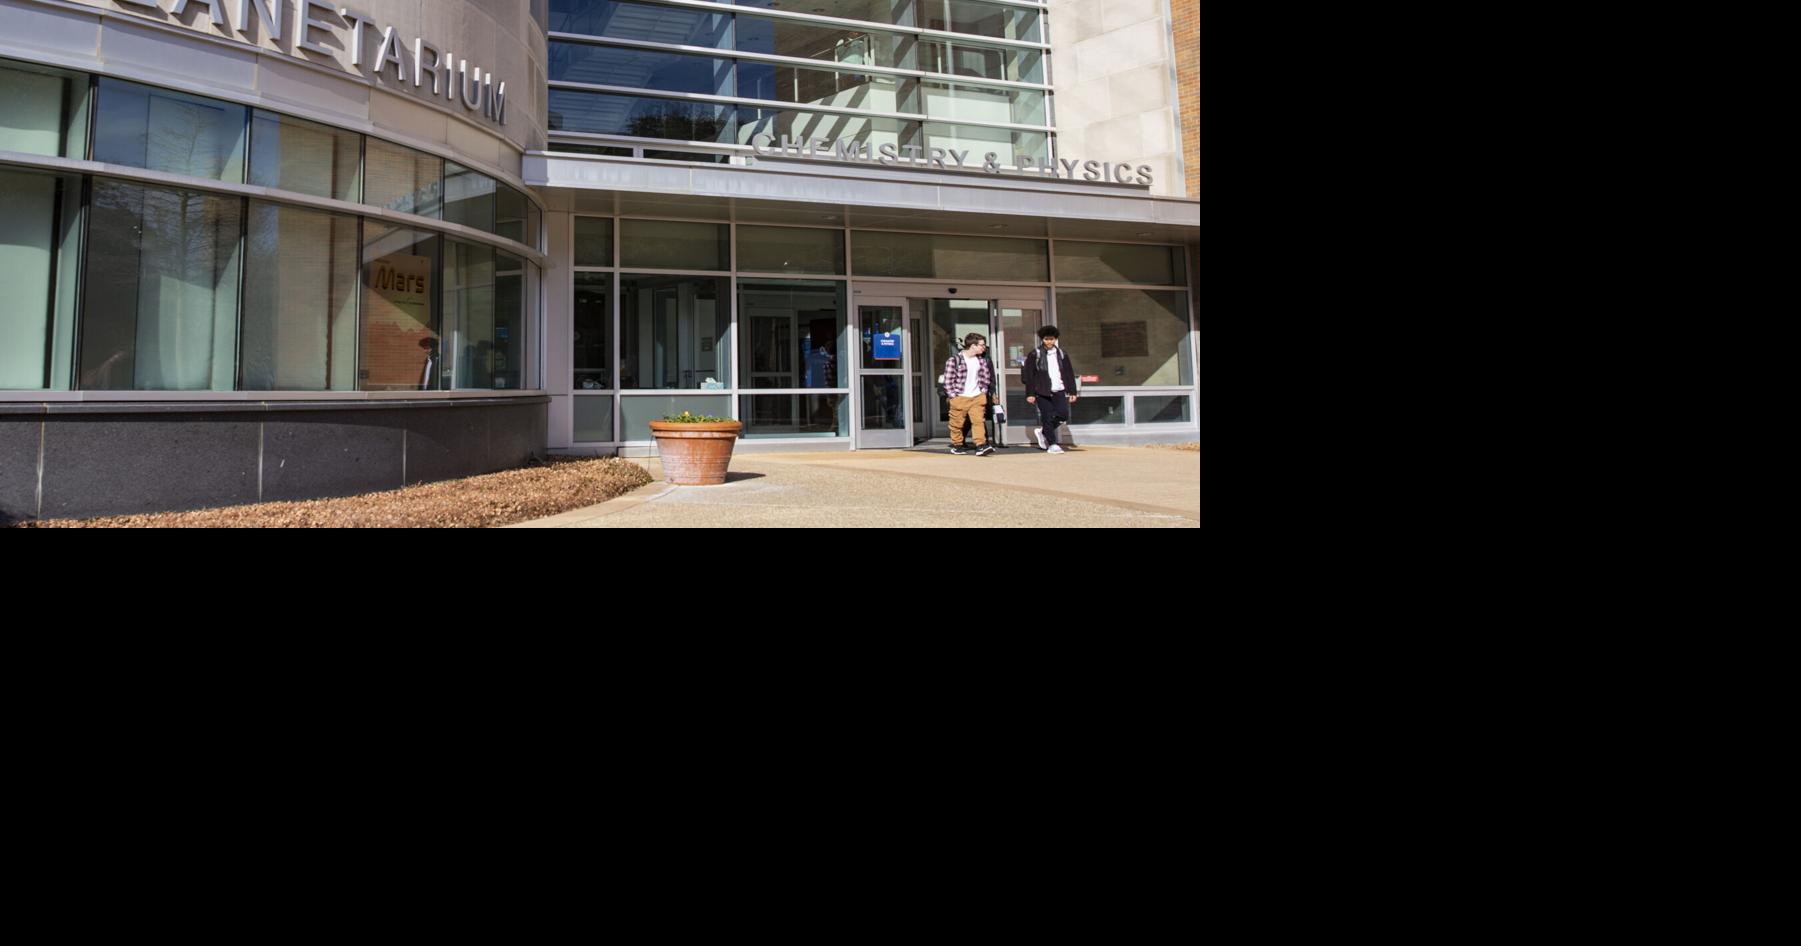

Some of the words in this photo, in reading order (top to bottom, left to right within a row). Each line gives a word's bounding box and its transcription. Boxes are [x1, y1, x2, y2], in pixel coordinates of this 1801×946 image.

[752, 132, 969, 169] CHEMISTRY
[983, 152, 1000, 174] &
[1016, 154, 1154, 185] PHYSICS
[374, 266, 425, 293] Mars
